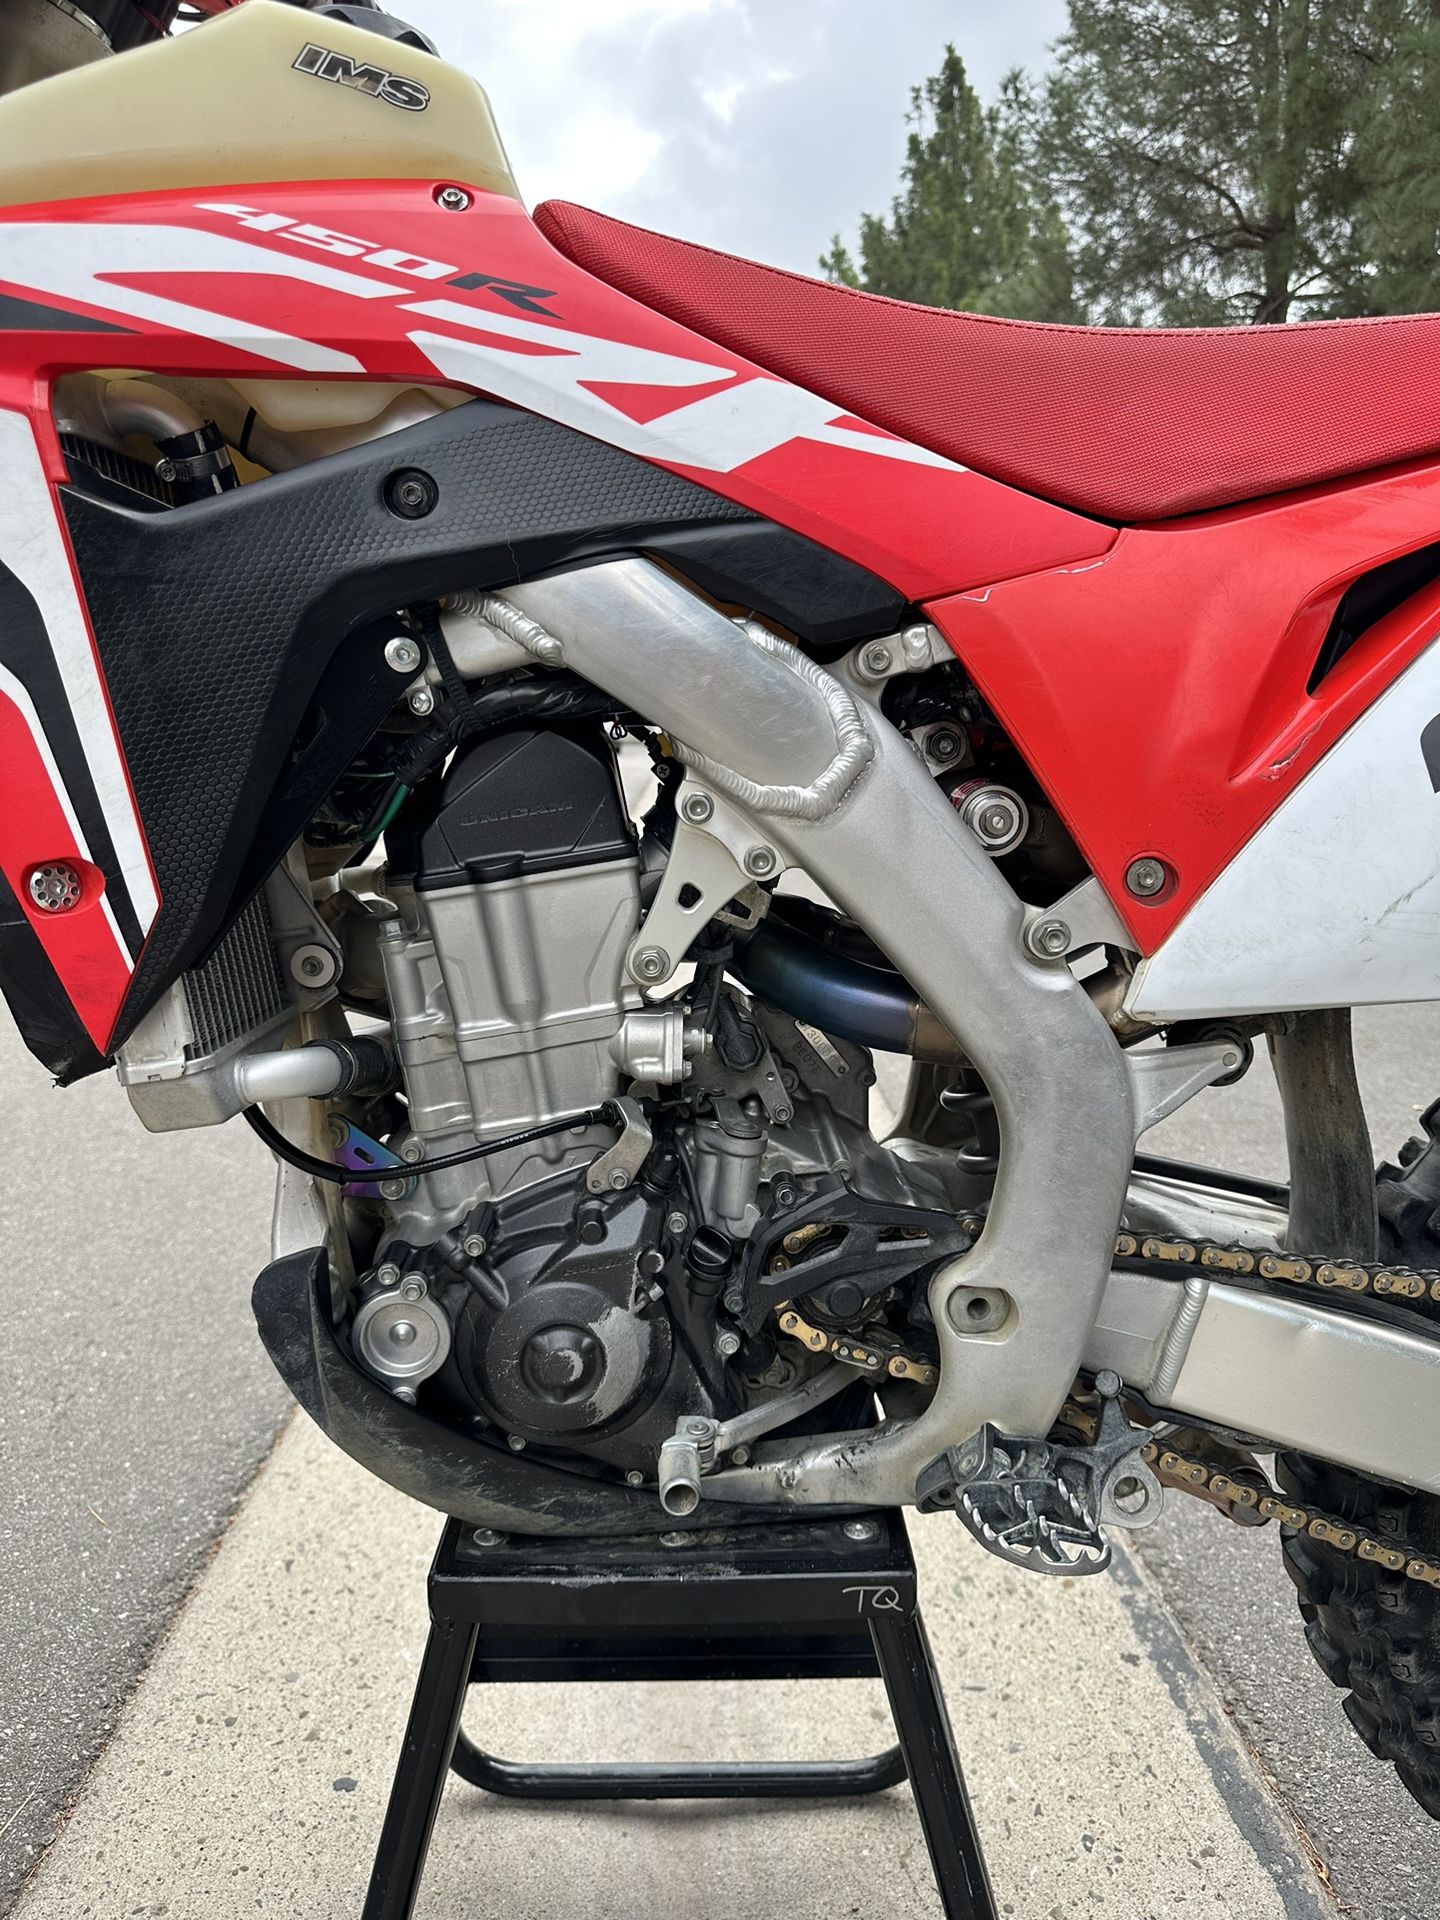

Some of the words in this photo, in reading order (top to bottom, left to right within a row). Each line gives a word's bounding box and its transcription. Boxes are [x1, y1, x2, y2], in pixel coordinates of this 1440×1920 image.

[291, 42, 431, 112] IMS
[194, 203, 565, 320] 450R
[842, 1585, 904, 1613] TQ
